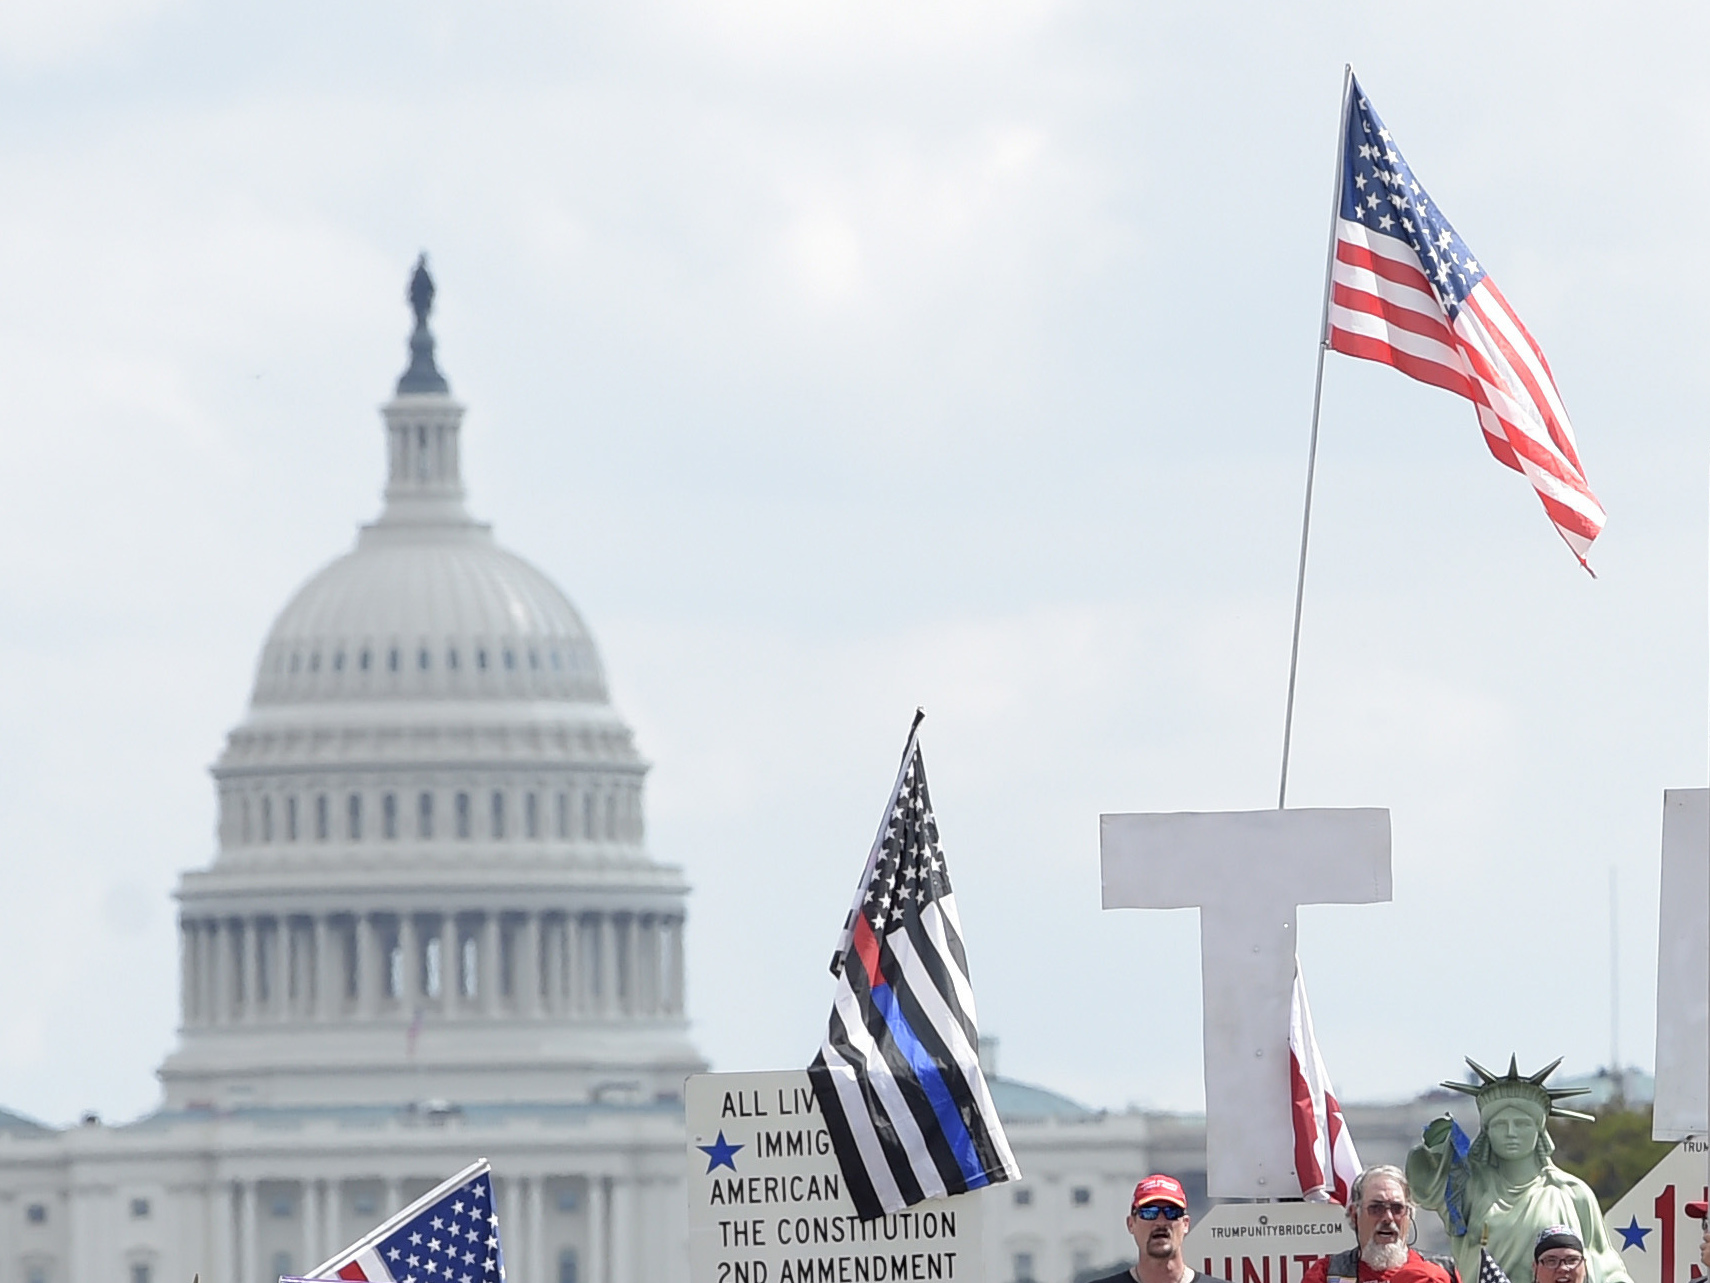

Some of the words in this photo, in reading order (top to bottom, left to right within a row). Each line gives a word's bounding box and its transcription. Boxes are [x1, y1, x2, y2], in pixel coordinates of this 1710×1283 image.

[721, 1091, 768, 1118] ALL
[778, 1088, 823, 1115] LIV
[757, 1130, 837, 1158] IMMIG
[710, 1174, 839, 1206] AMERICAN
[718, 1219, 766, 1248] THE
[778, 1211, 957, 1245] CONSTITUTION
[1211, 1223, 1342, 1238] TRUMPUNITYBRIDGE.COM
